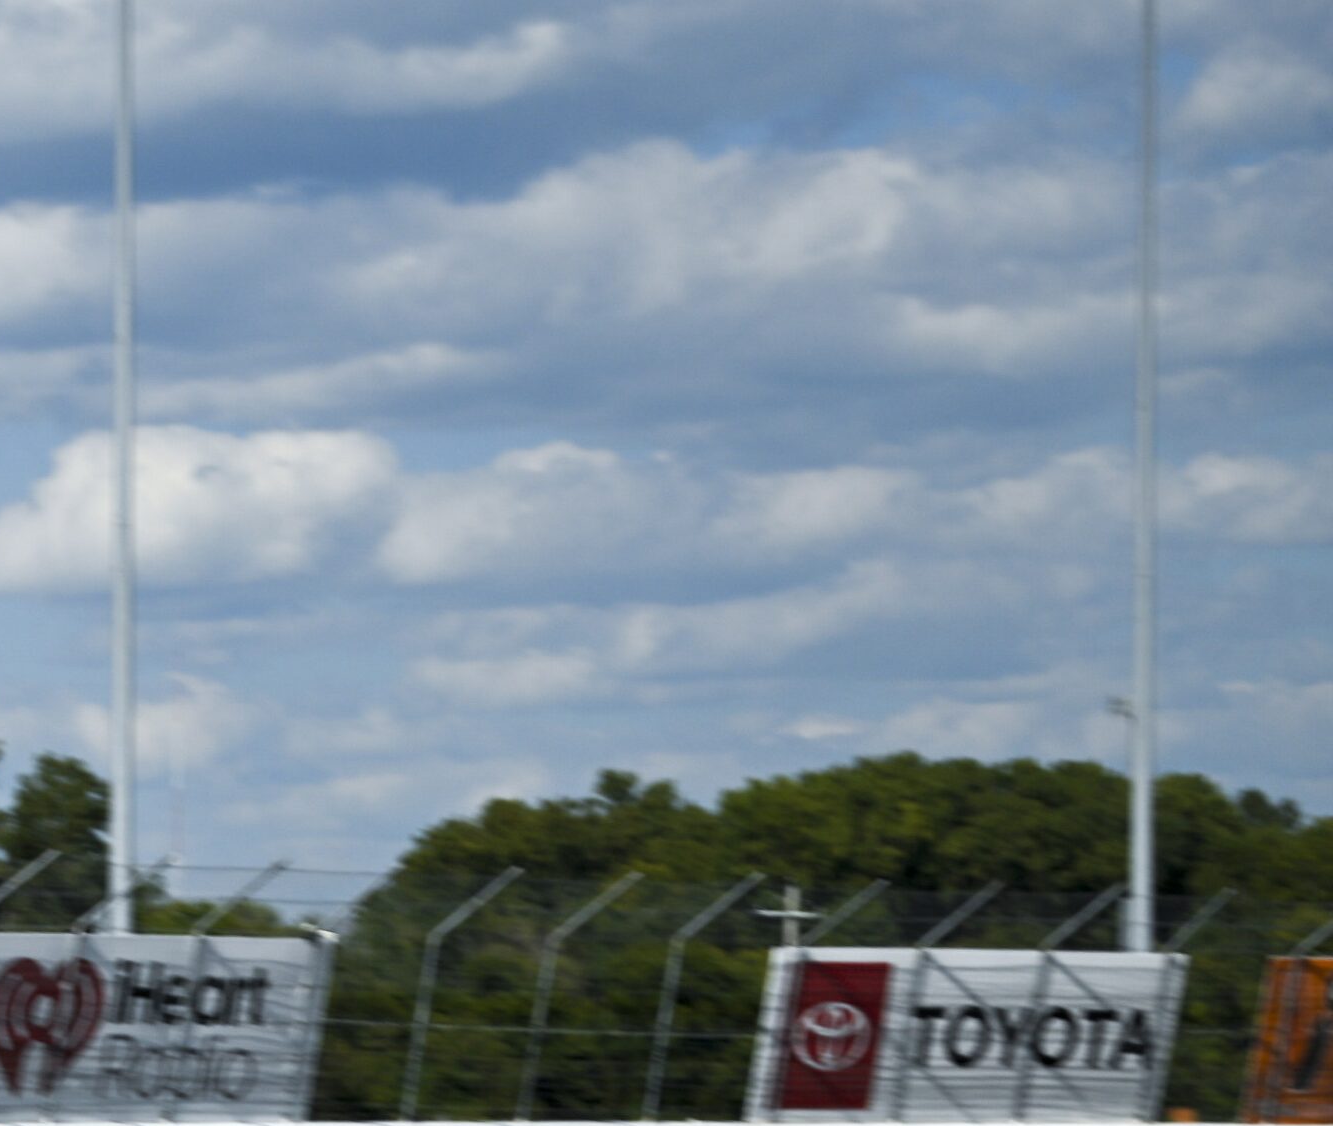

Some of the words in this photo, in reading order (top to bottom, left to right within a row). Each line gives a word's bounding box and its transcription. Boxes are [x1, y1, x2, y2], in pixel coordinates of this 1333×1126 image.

[114, 957, 271, 1026] iHeart
[97, 1034, 260, 1100] Radio
[912, 1005, 1153, 1069] TOYOTA
